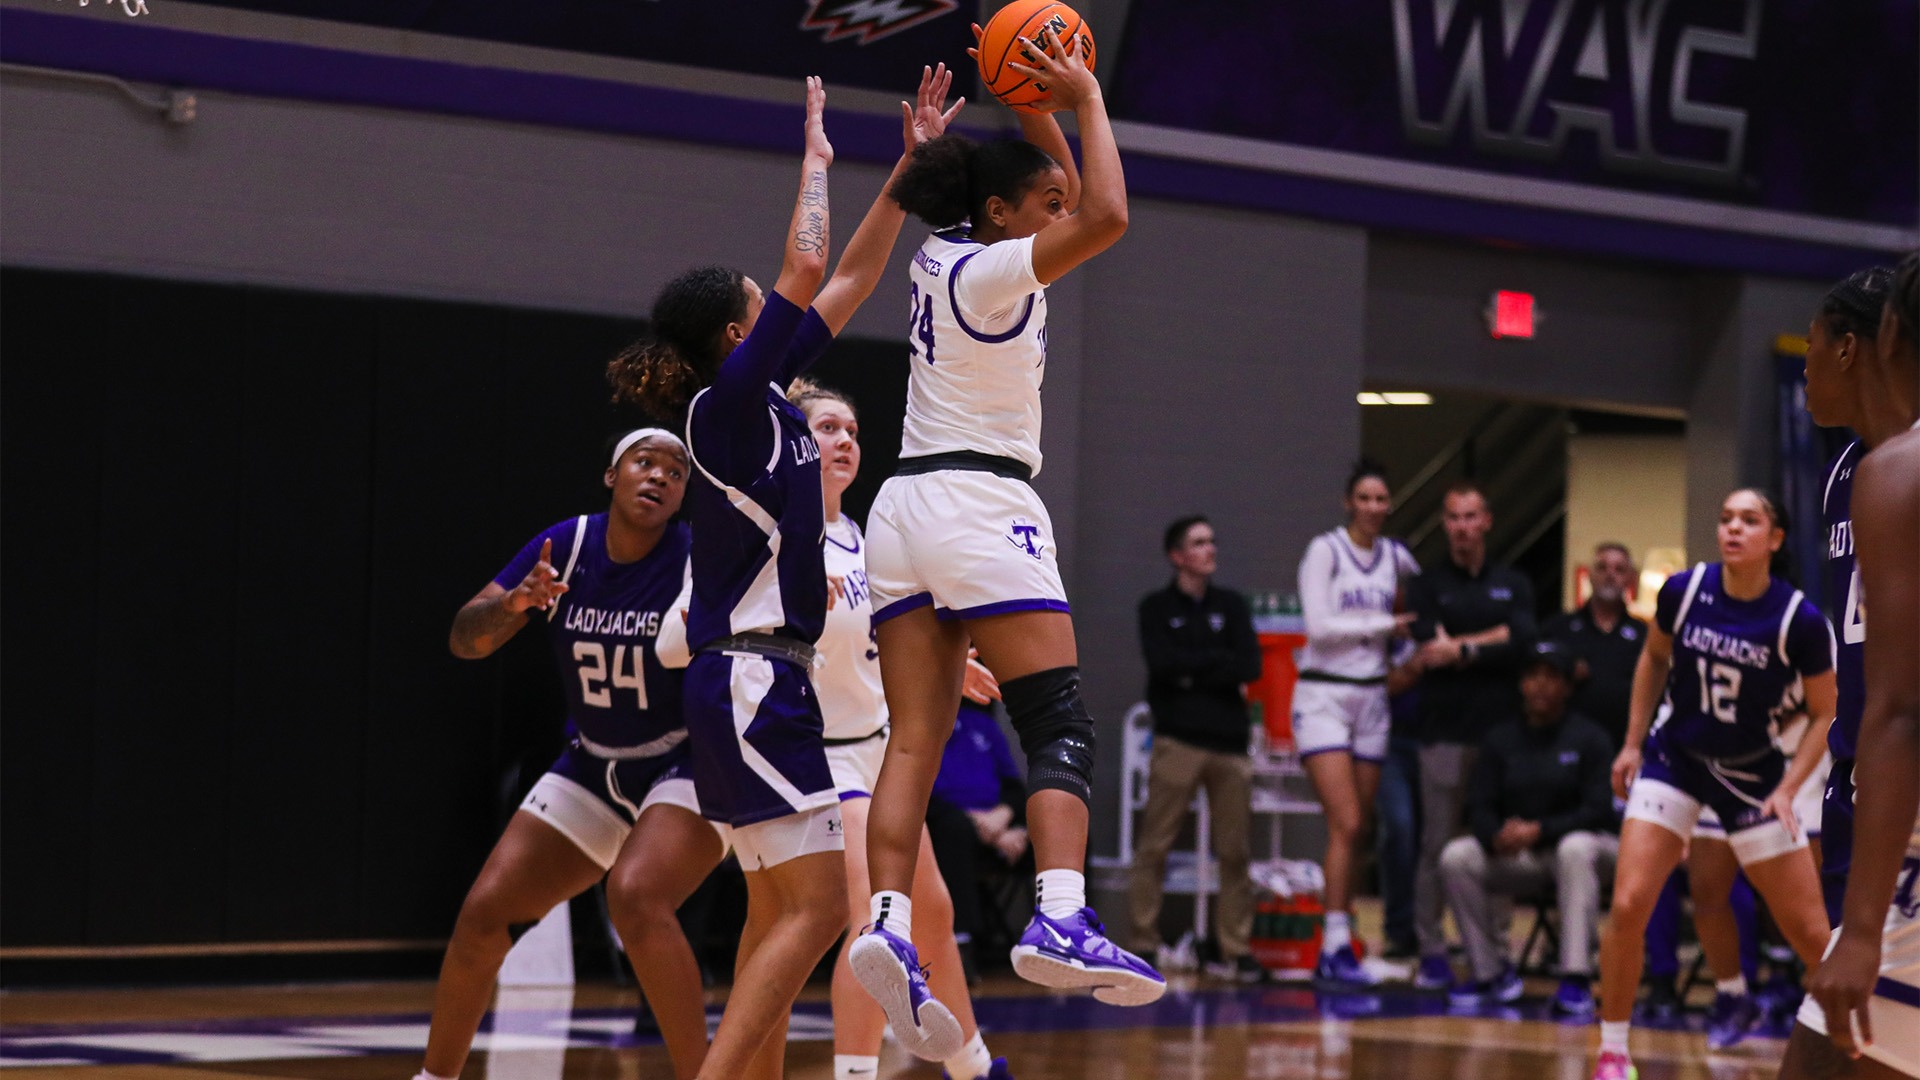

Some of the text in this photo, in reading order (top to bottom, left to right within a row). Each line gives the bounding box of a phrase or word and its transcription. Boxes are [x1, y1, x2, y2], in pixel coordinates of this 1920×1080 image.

[1392, 0, 1761, 185] WAC
[795, 211, 824, 258] Love
[564, 603, 660, 637] LADYJACKS
[1682, 622, 1771, 670] LADYJACKS
[572, 641, 648, 710] 24
[1697, 656, 1742, 723] 12
